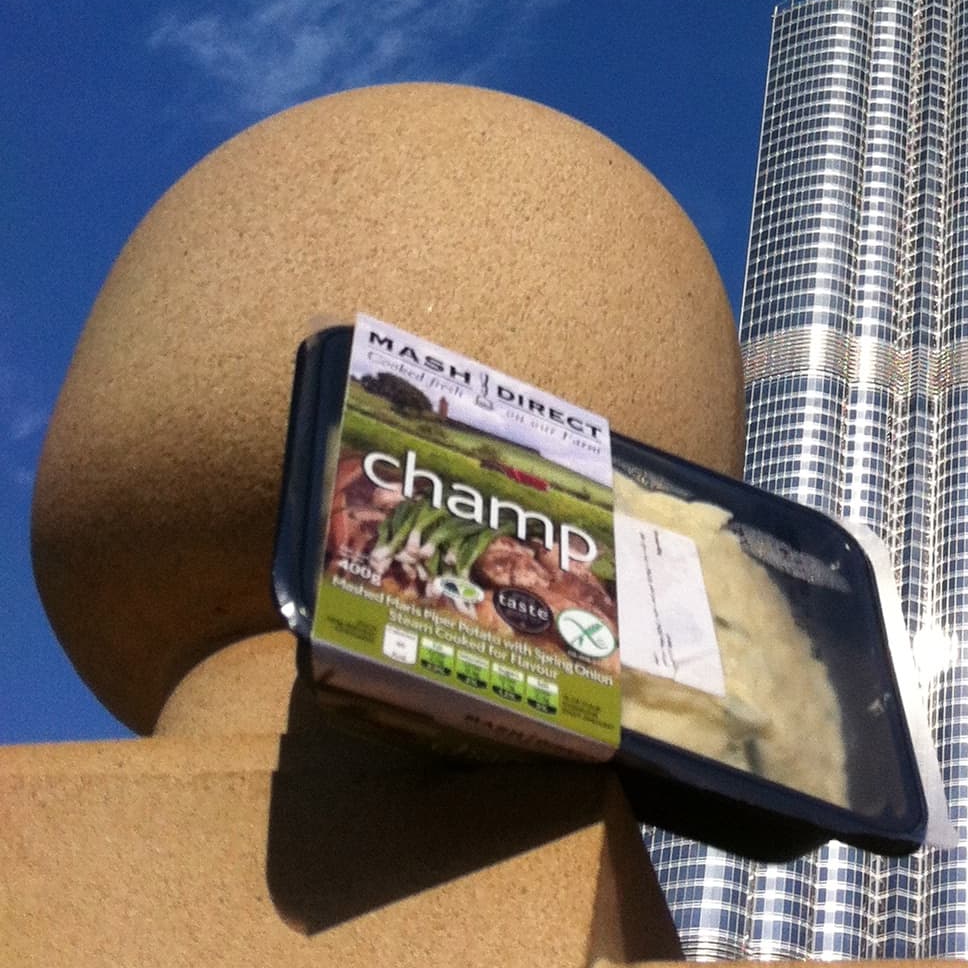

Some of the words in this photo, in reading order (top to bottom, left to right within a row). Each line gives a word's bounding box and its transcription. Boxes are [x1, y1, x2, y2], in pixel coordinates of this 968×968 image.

[369, 331, 471, 384] MASH
[497, 385, 602, 438] DIRECT
[363, 450, 598, 572] champ
[337, 559, 382, 587] 400g
[498, 593, 550, 622] taste
[332, 575, 385, 604] Mashed
[458, 620, 502, 646] Potato
[503, 637, 529, 656] with
[534, 647, 574, 677] Spring
[575, 665, 614, 687] Onion
[389, 609, 434, 635] Steam
[435, 627, 487, 654] Cooked
[488, 643, 508, 661] for
[511, 653, 558, 680] Flavour
